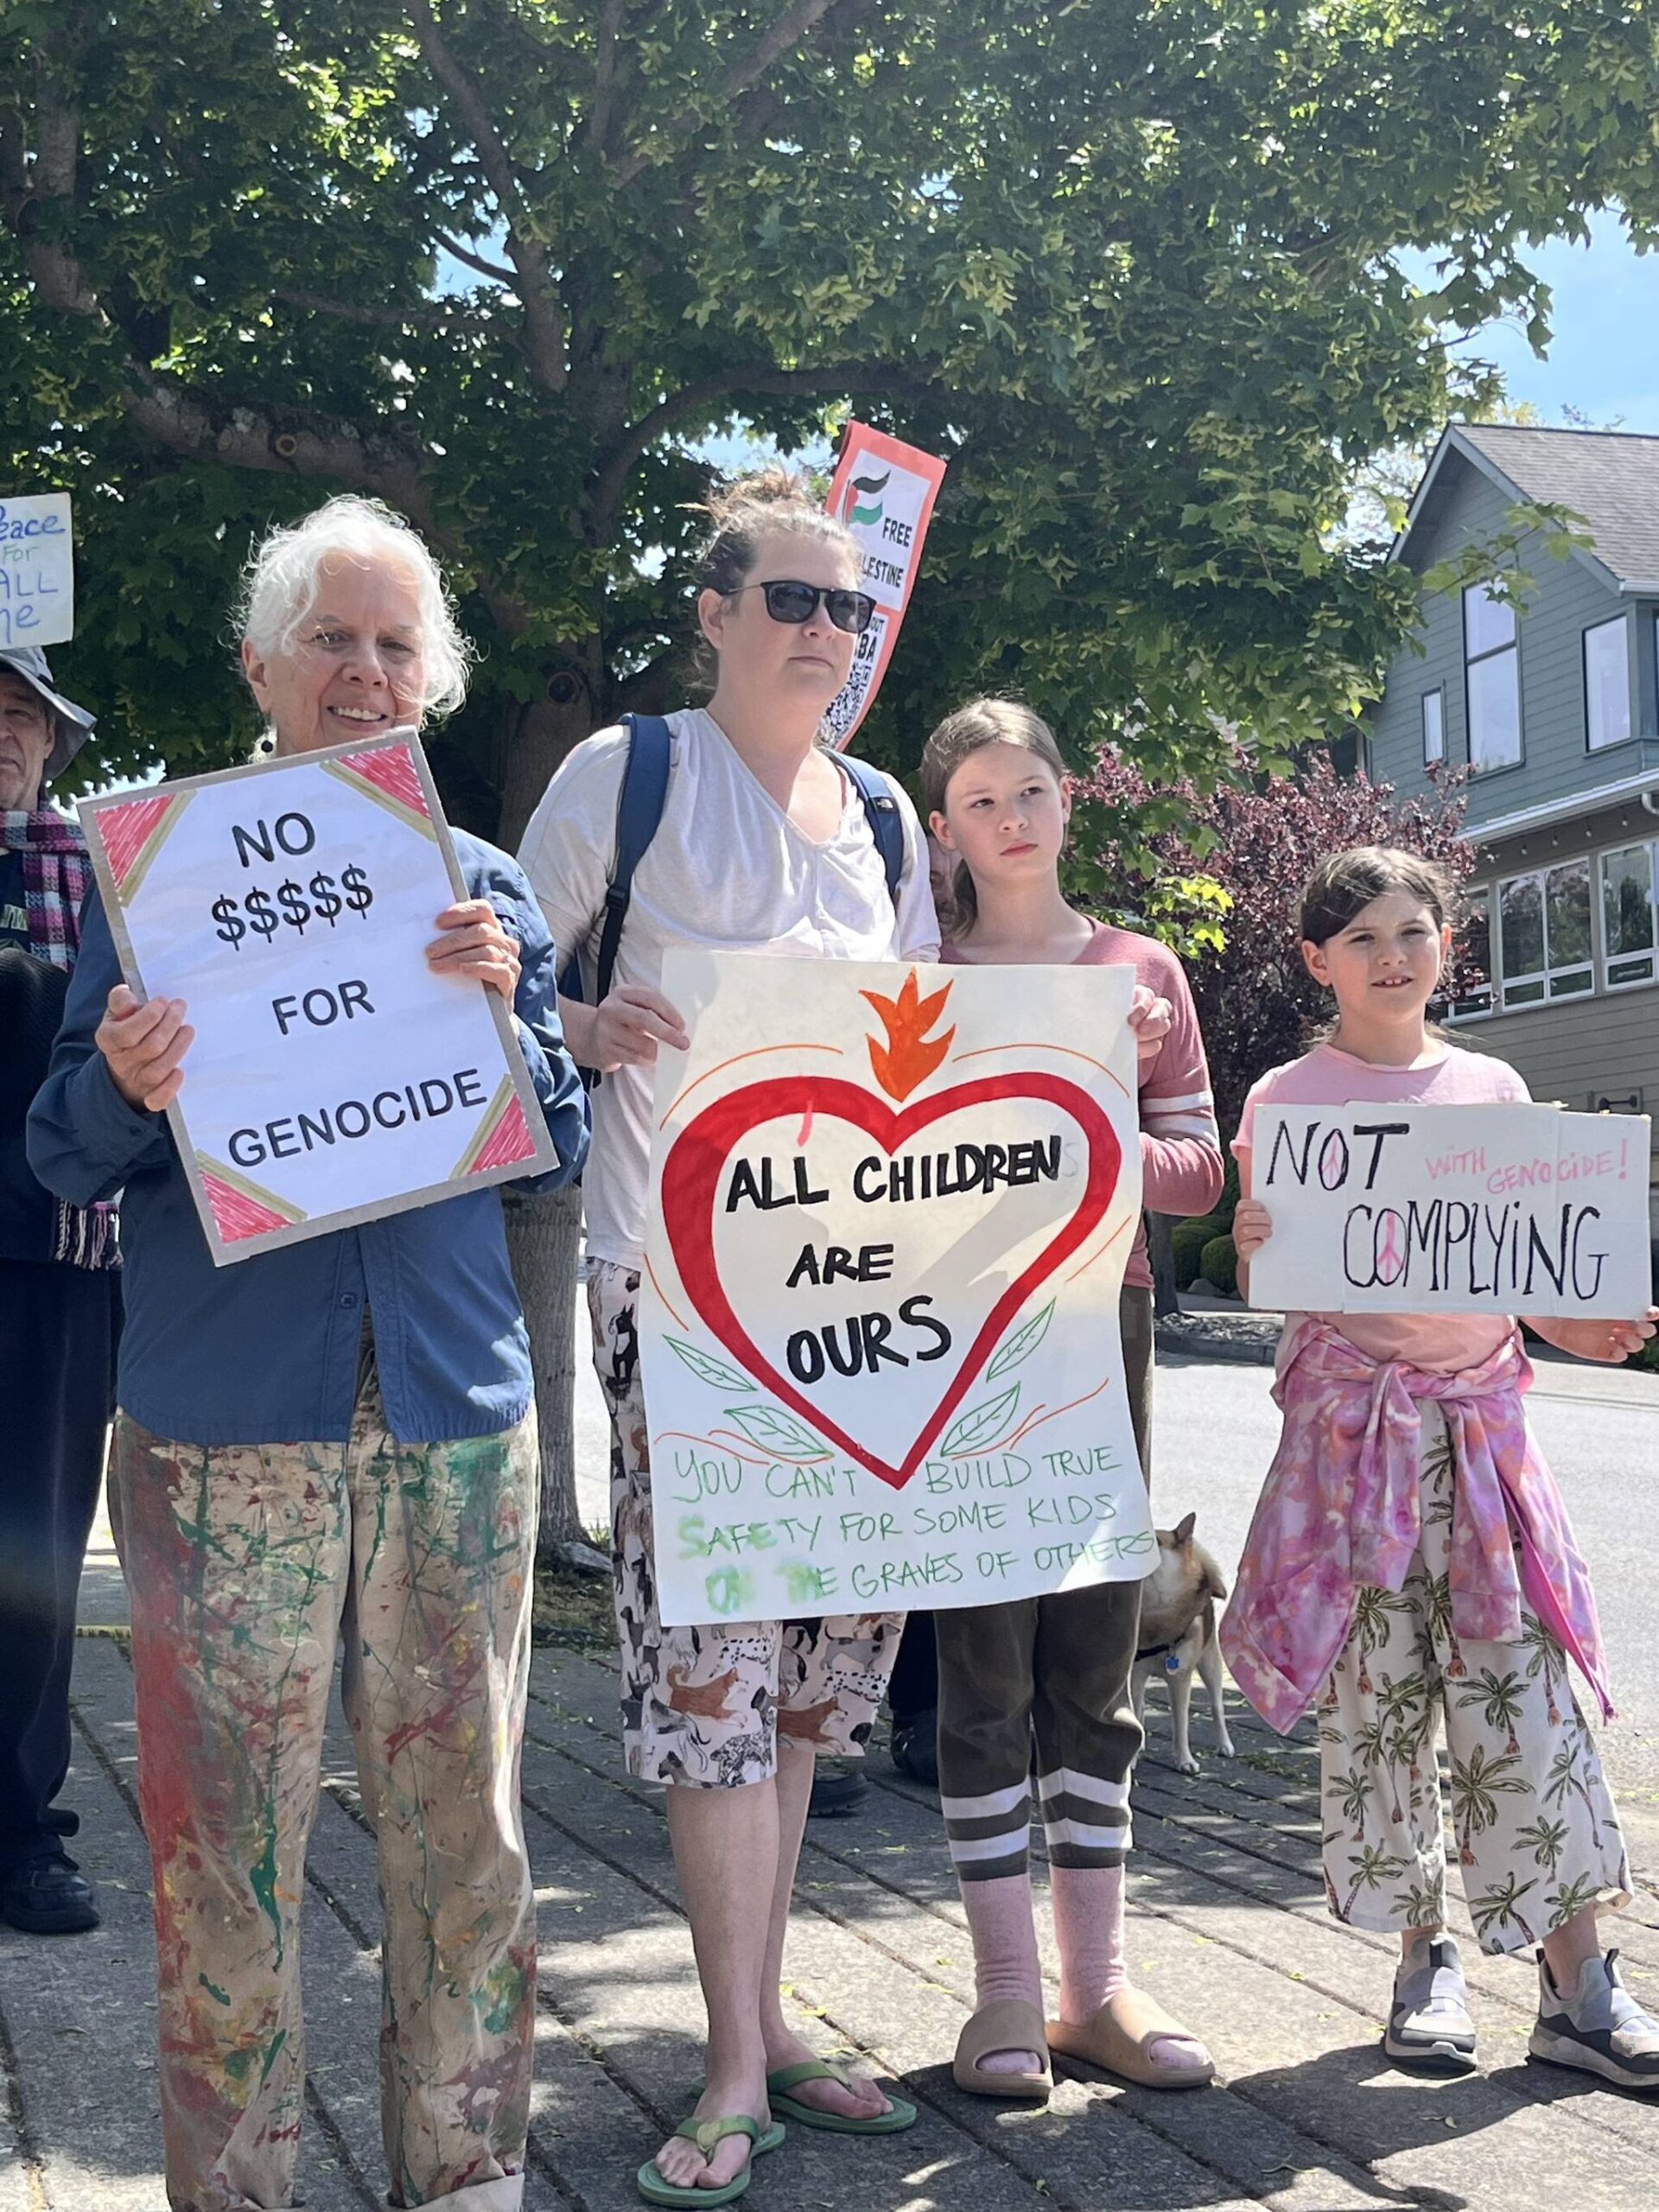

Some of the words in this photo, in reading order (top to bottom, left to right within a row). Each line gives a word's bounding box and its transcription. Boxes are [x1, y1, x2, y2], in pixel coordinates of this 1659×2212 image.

[882, 517, 912, 548] FREE
[862, 554, 904, 588] LESTINE
[232, 812, 315, 868] NO
[211, 863, 373, 951] $$$$$
[272, 979, 376, 1035] FOR
[228, 1069, 488, 1167] GENOCIDE
[725, 1156, 830, 1212] ALL
[853, 1135, 1062, 1203] CHILDREN
[1266, 1120, 1410, 1191] NOT
[785, 1243, 894, 1288] ARE
[786, 1295, 951, 1384] OURS
[672, 1449, 742, 1503] YOU
[766, 1464, 856, 1498] CAN'T
[926, 1453, 1032, 1493] BUILD
[1042, 1446, 1122, 1476] TRUE
[679, 1513, 822, 1560] SAFETY
[840, 1512, 903, 1541] FOR
[914, 1502, 1007, 1535] SOME
[1028, 1494, 1116, 1528] KIDS
[851, 1553, 963, 1599] GRAVES
[976, 1551, 1020, 1578] OF
[1034, 1531, 1154, 1571] OTHERS
